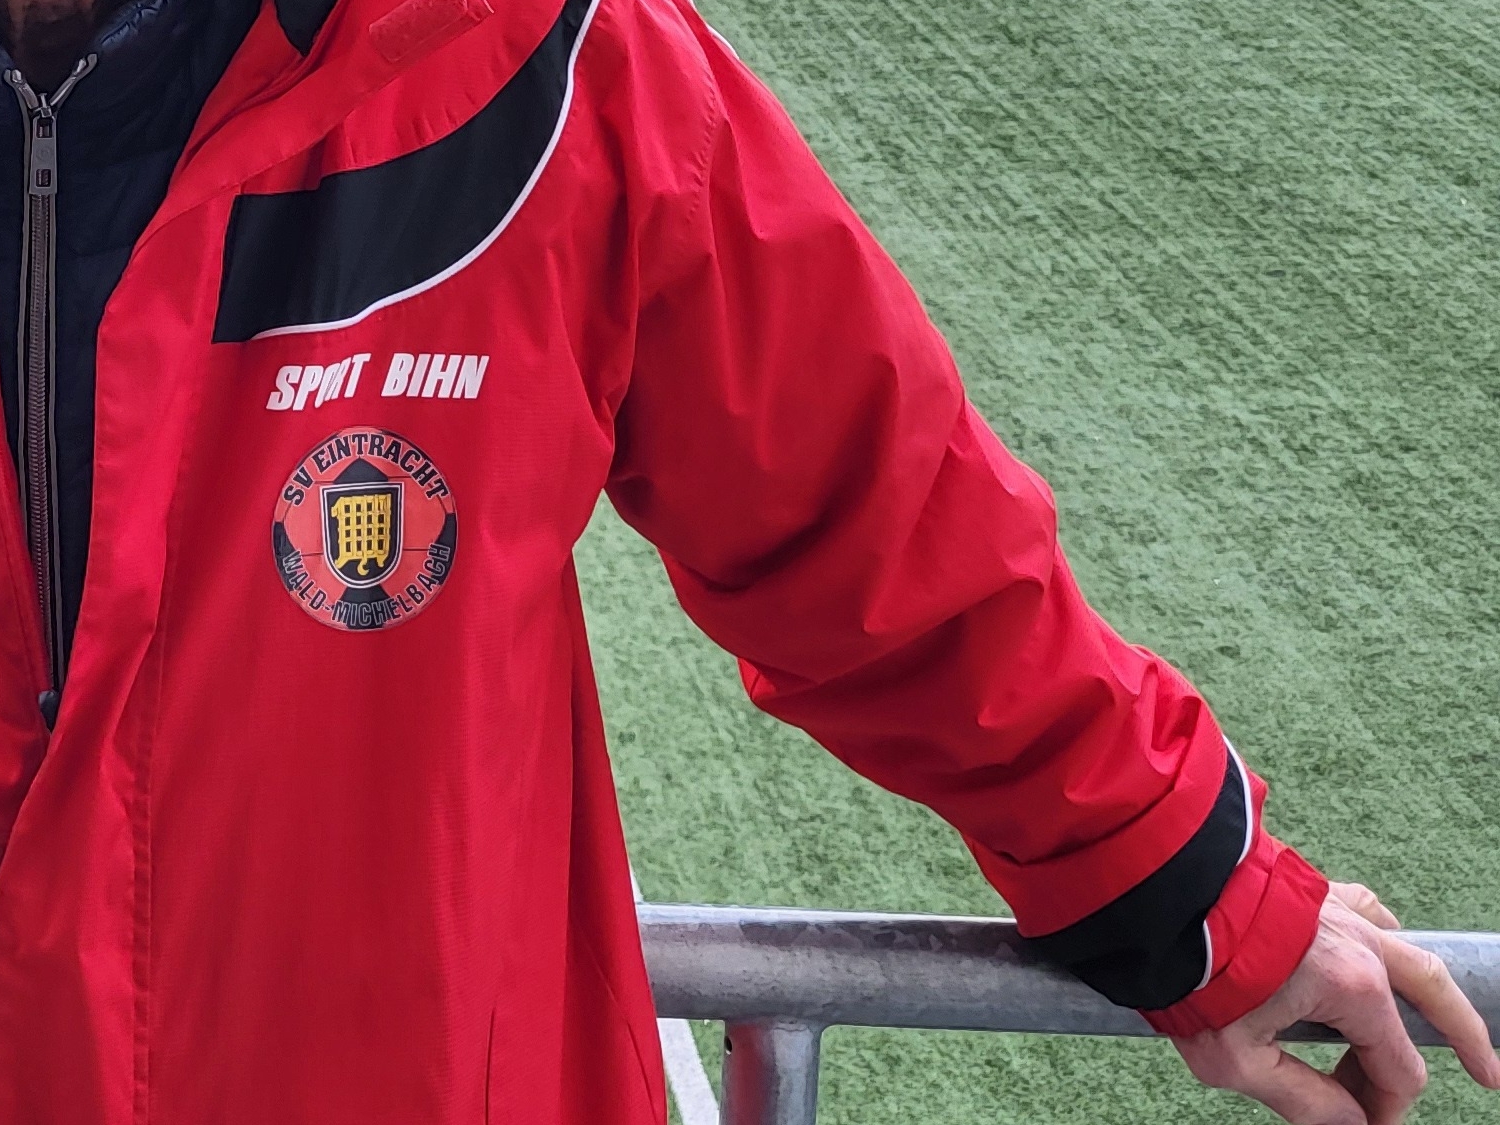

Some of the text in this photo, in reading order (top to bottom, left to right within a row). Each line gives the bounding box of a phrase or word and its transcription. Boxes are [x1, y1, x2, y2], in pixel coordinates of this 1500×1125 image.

[381, 353, 490, 400] BIHN
[284, 433, 449, 506] SV EINTRACHT
